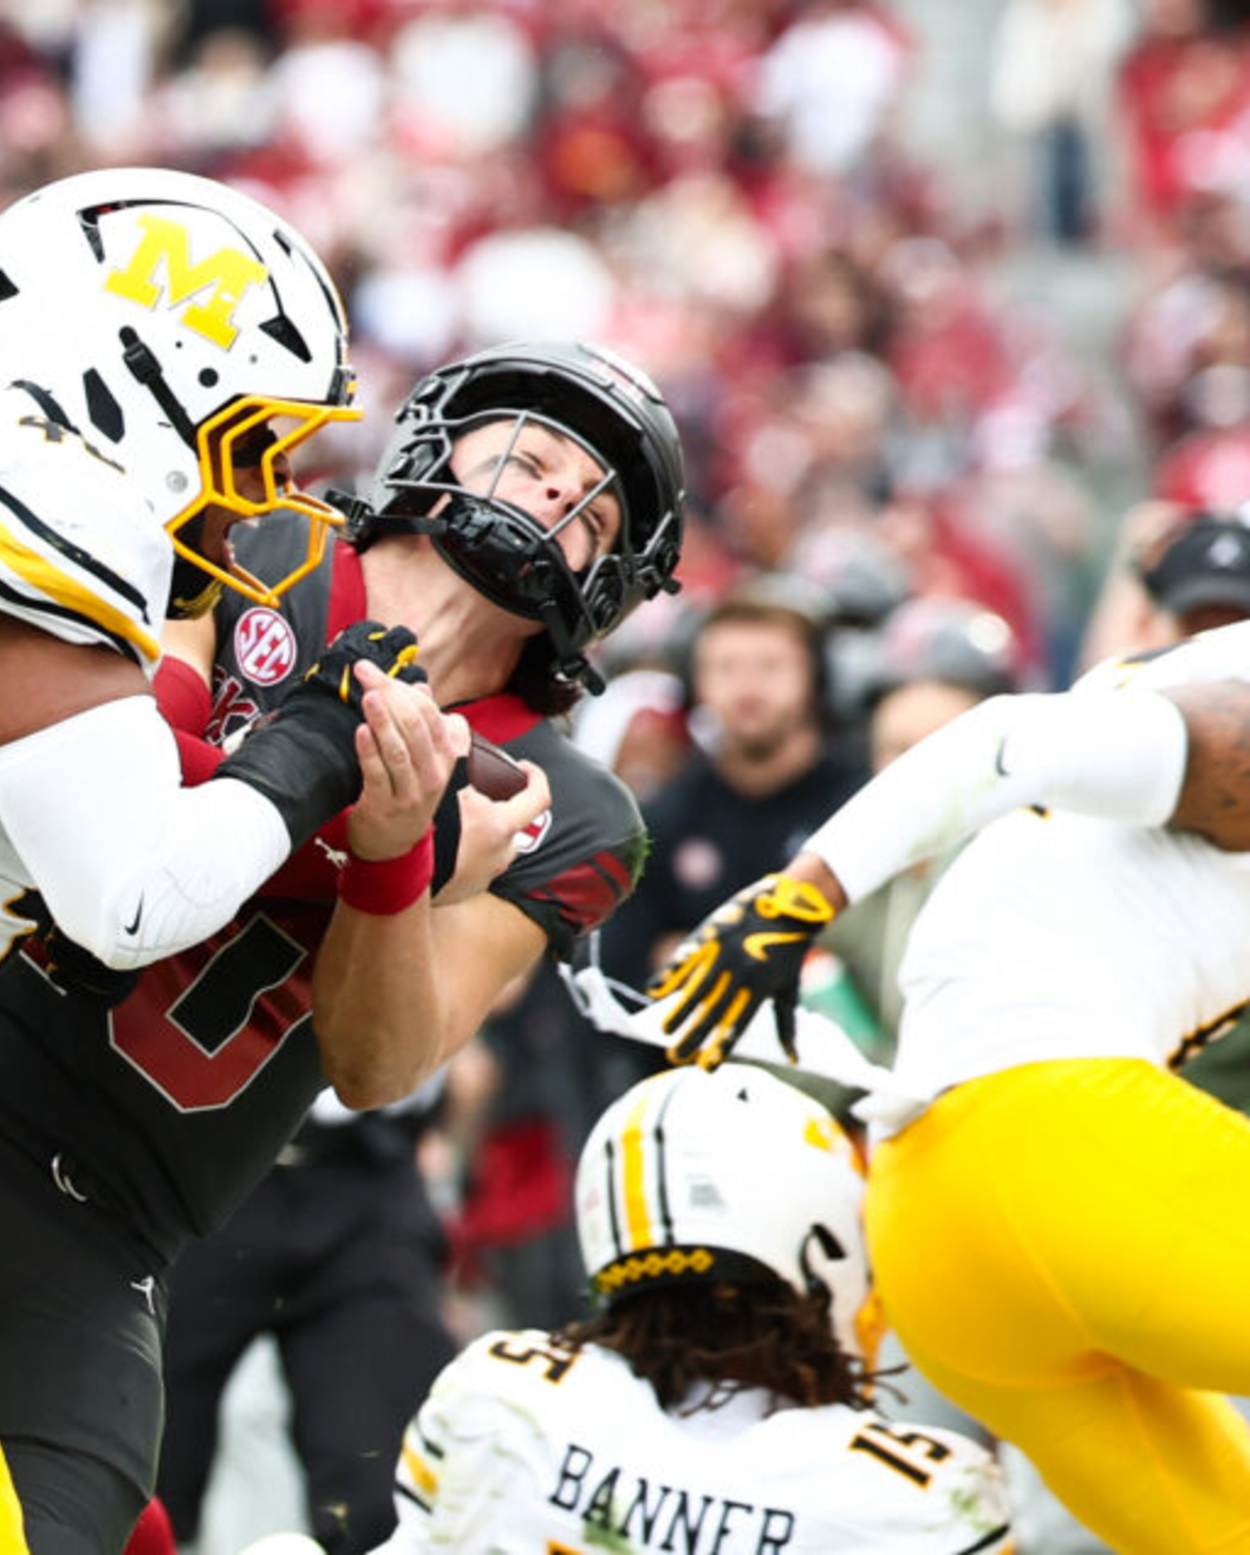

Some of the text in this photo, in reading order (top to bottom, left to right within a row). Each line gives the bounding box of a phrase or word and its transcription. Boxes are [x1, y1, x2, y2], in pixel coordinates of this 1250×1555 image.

[104, 214, 269, 351] M
[237, 610, 292, 682] SEC
[548, 1443, 795, 1555] BANNER
[848, 1421, 954, 1490] 15
